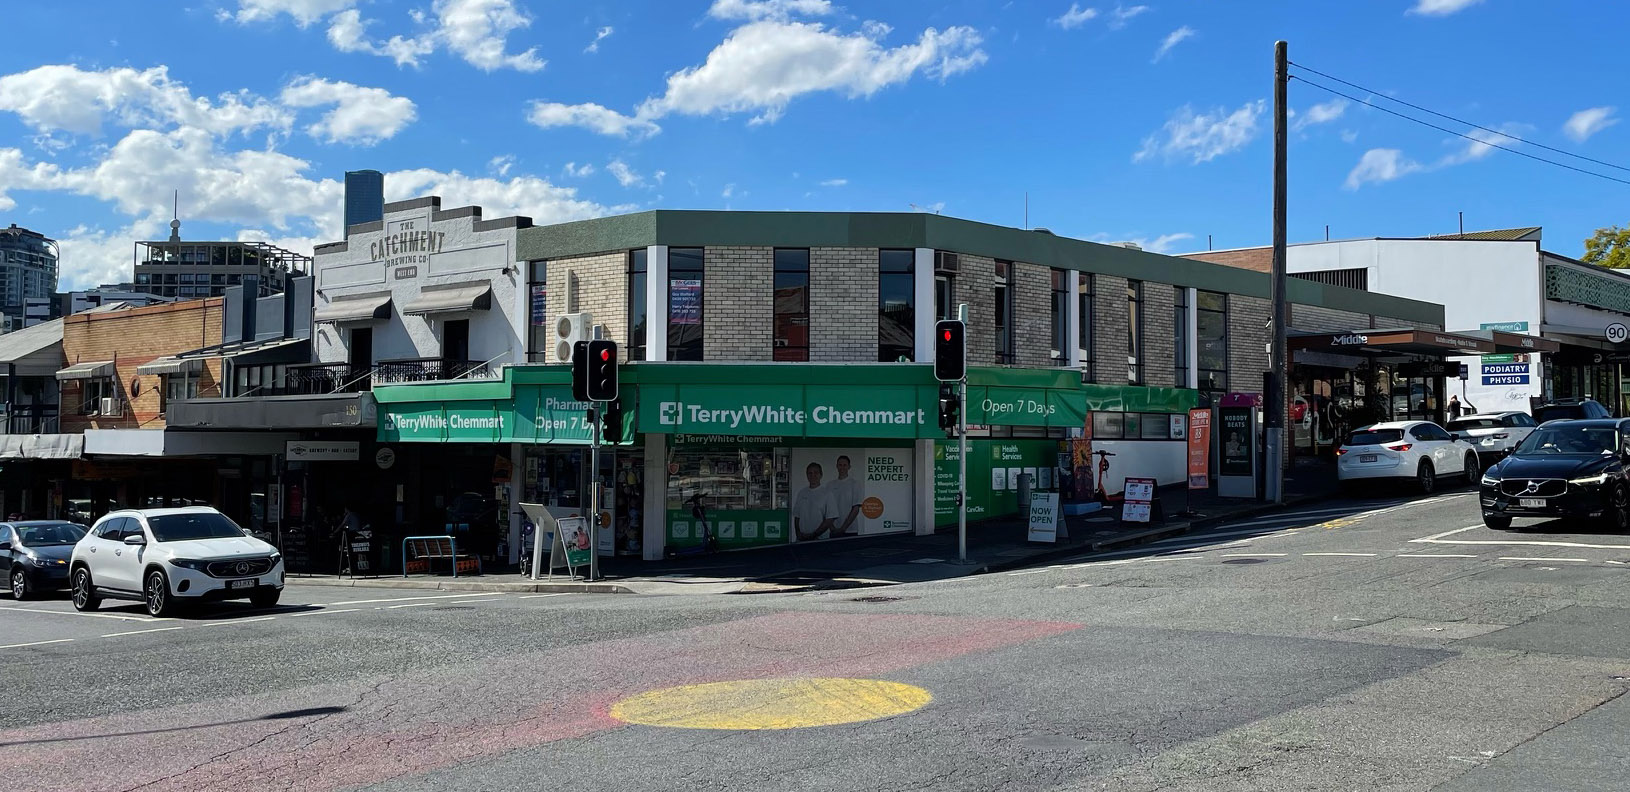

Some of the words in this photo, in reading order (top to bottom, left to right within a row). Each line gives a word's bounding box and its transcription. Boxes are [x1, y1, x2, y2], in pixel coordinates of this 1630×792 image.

[400, 221, 414, 231] THE
[370, 230, 445, 261] CATCHMENT
[386, 255, 417, 268] BREWING
[1608, 327, 1625, 339] 90
[1331, 335, 1368, 346] Middle
[1484, 365, 1526, 373] PODIATRY
[545, 397, 602, 411] Pharmac
[981, 398, 1014, 416] Open
[1017, 399, 1024, 413] 7
[1027, 399, 1056, 416] Days
[687, 405, 807, 428] TerryWhite
[812, 406, 925, 424] Chemmart
[396, 415, 448, 432] TerryWhite
[450, 415, 504, 429] Chemmart
[535, 416, 567, 432] Open
[570, 416, 578, 430] 7
[685, 434, 736, 445] TerryWhite
[736, 434, 783, 444] Chemmart
[1002, 444, 1018, 452] Health
[868, 465, 904, 473] EXPERT
[1031, 507, 1052, 515] NOW
[1030, 516, 1053, 524] OPEN
